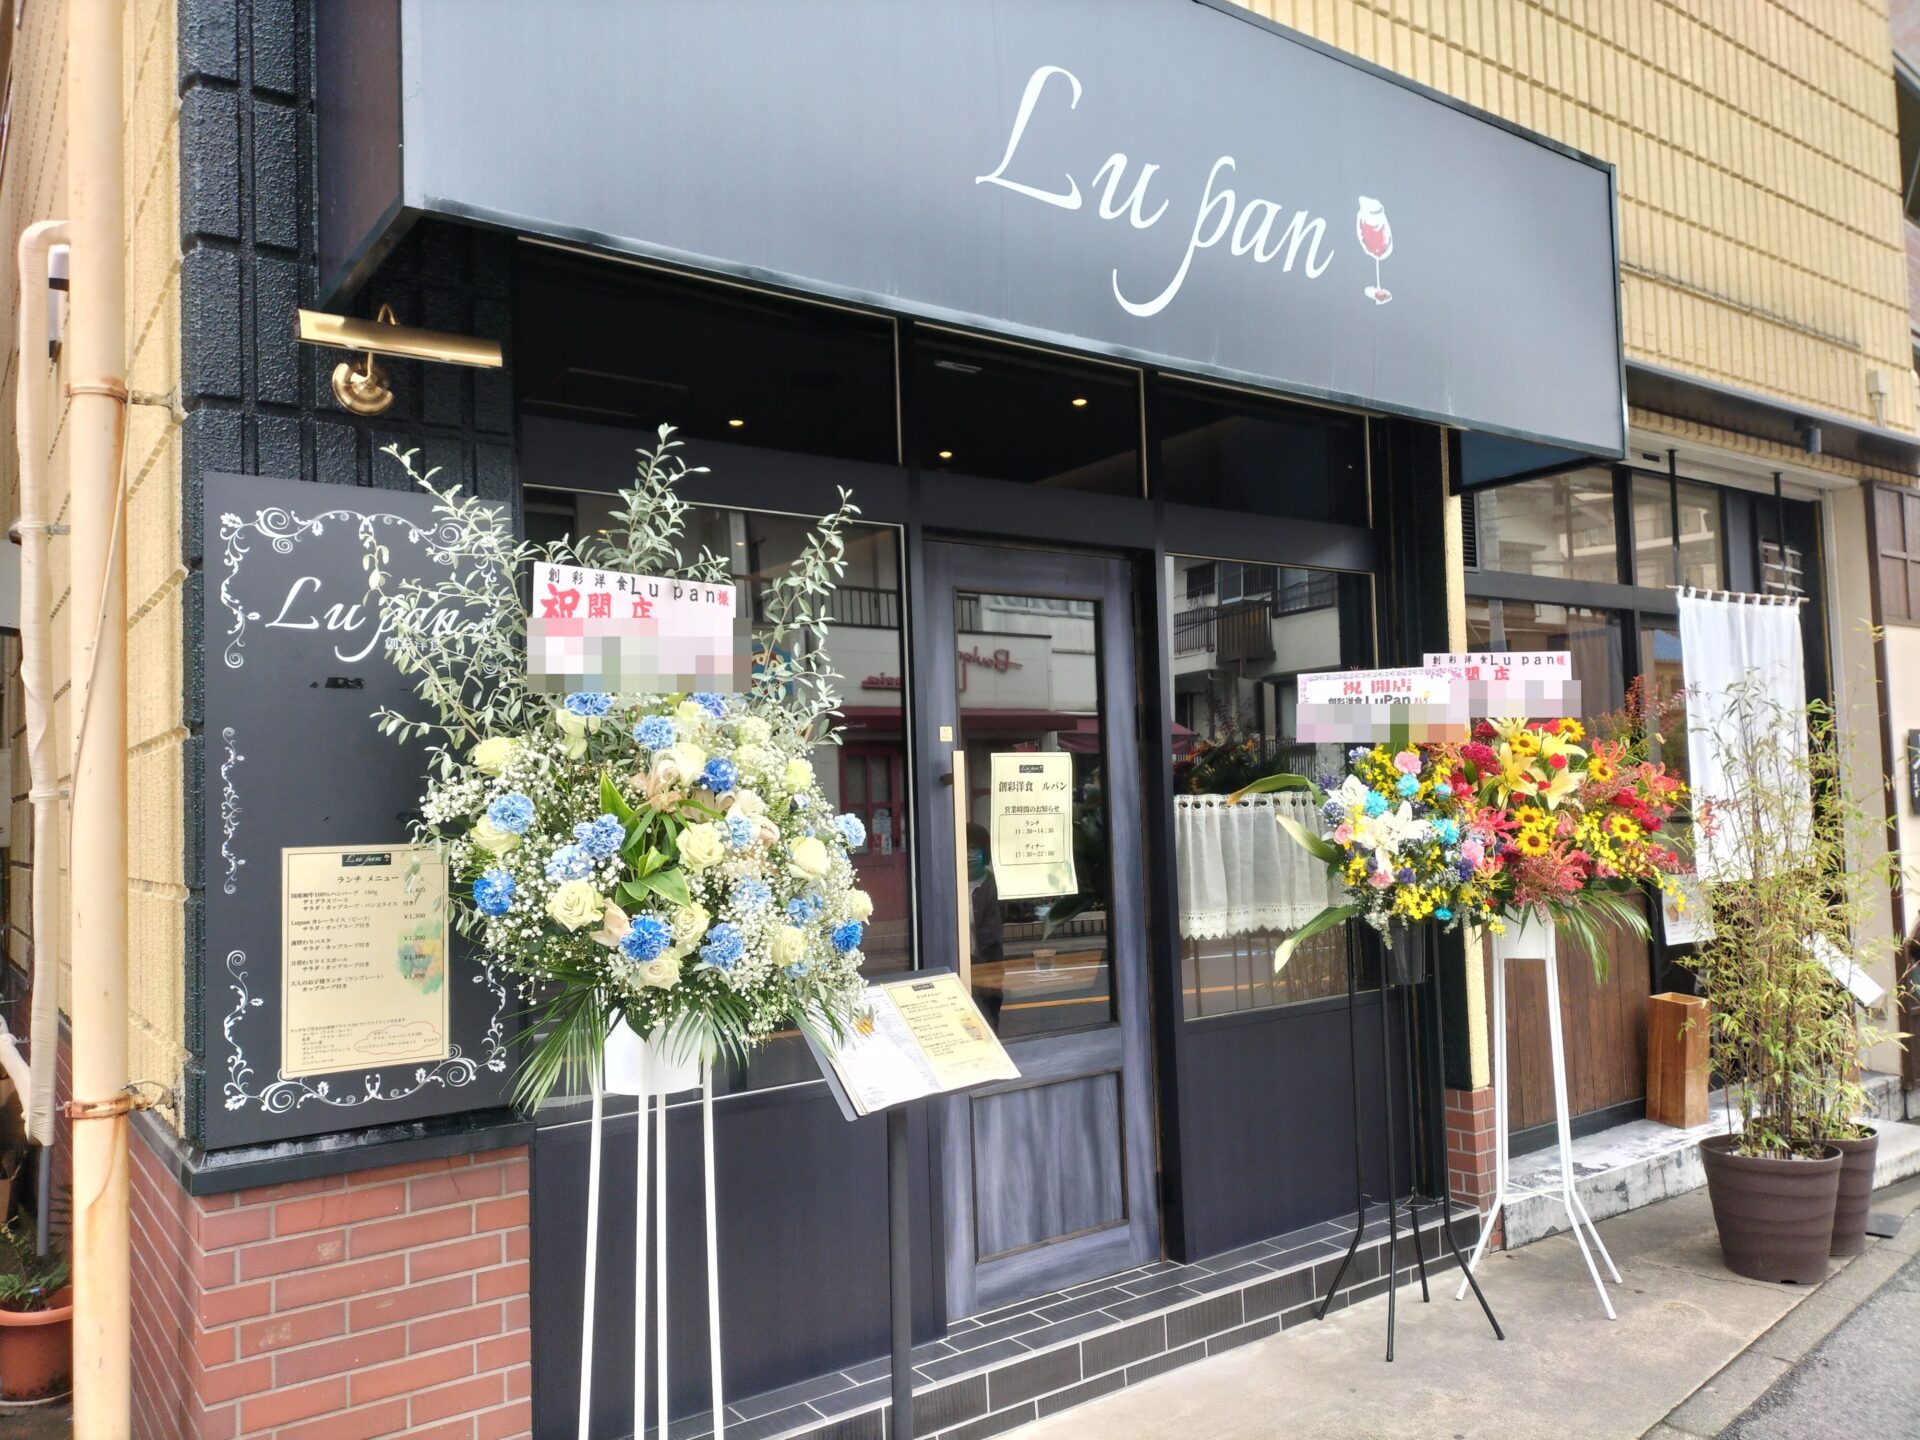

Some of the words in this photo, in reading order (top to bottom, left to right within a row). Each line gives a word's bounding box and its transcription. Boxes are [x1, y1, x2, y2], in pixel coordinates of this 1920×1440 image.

[975, 65, 1169, 229] Lu
[1112, 155, 1335, 317] pan
[265, 576, 367, 631] Lu
[1043, 781, 1067, 791] ルパン
[337, 875, 362, 884] ランチ
